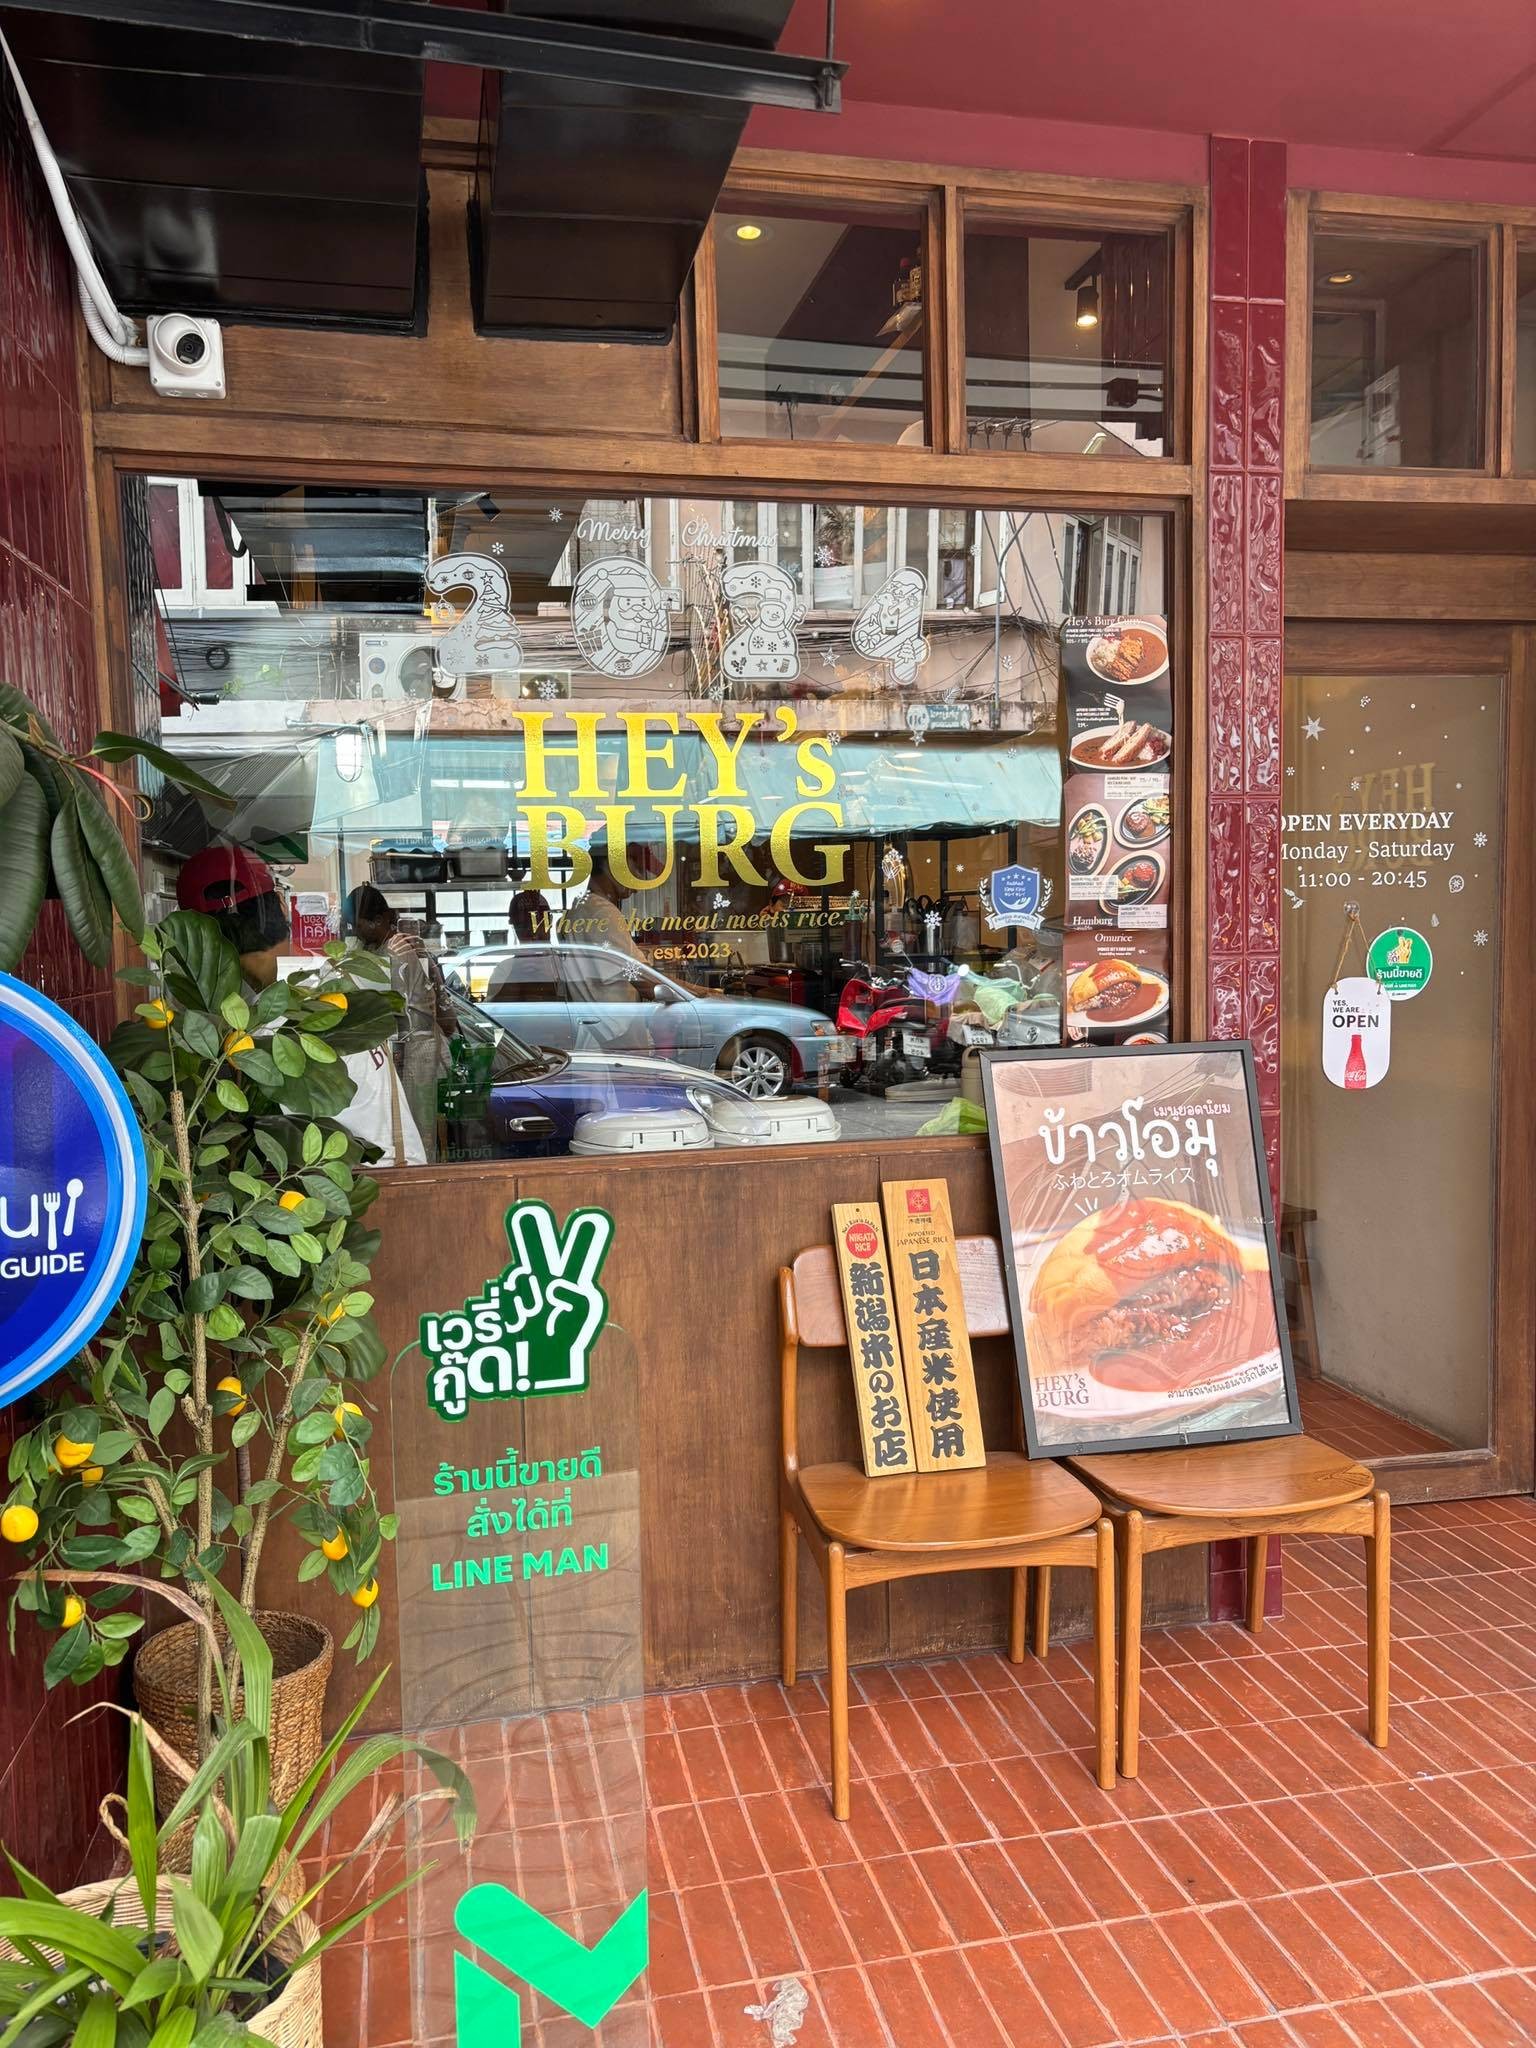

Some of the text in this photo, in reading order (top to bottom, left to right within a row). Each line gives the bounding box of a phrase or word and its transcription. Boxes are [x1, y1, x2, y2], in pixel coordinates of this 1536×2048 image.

[577, 518, 779, 549] Merry Christmas
[512, 705, 837, 798] HEY's
[1339, 811, 1454, 831] EVERYDAY
[517, 802, 850, 890] BURG
[1368, 839, 1454, 861] Saturday
[1298, 872, 1351, 888] 11:00
[1371, 871, 1427, 888] 20:45
[528, 910, 609, 934] Where
[616, 908, 654, 932] the
[726, 911, 790, 930] meets
[799, 911, 845, 928] rice.
[1073, 916, 1113, 926] Hamburg
[1095, 933, 1133, 943] Omurice
[653, 943, 732, 961] est.2023
[1377, 965, 1423, 979] ร้านนี้ขายดี
[1332, 1015, 1379, 1028] OPEN
[1153, 1099, 1231, 1121] เมนูยอดนิยม
[1038, 1096, 1218, 1177] ข้าวโอมุ
[1052, 1166, 1196, 1191] ふわとろオムライス
[849, 1232, 876, 1242] NIIGATA
[855, 1243, 871, 1252] RICE
[897, 1237, 930, 1247] JAPANESE
[0, 1252, 85, 1279] GUIDE
[428, 1286, 503, 1352] เวรี่
[849, 1262, 908, 1468] 新潟米のお店
[907, 1249, 966, 1459] 日本産米使用
[1035, 1372, 1086, 1392] HEY's
[1037, 1389, 1090, 1408] BURG
[434, 1446, 602, 1495] ร้านนี้ขายดี
[466, 1487, 573, 1538] สั่งได้ที่
[432, 1542, 609, 1592] LINE MAN
